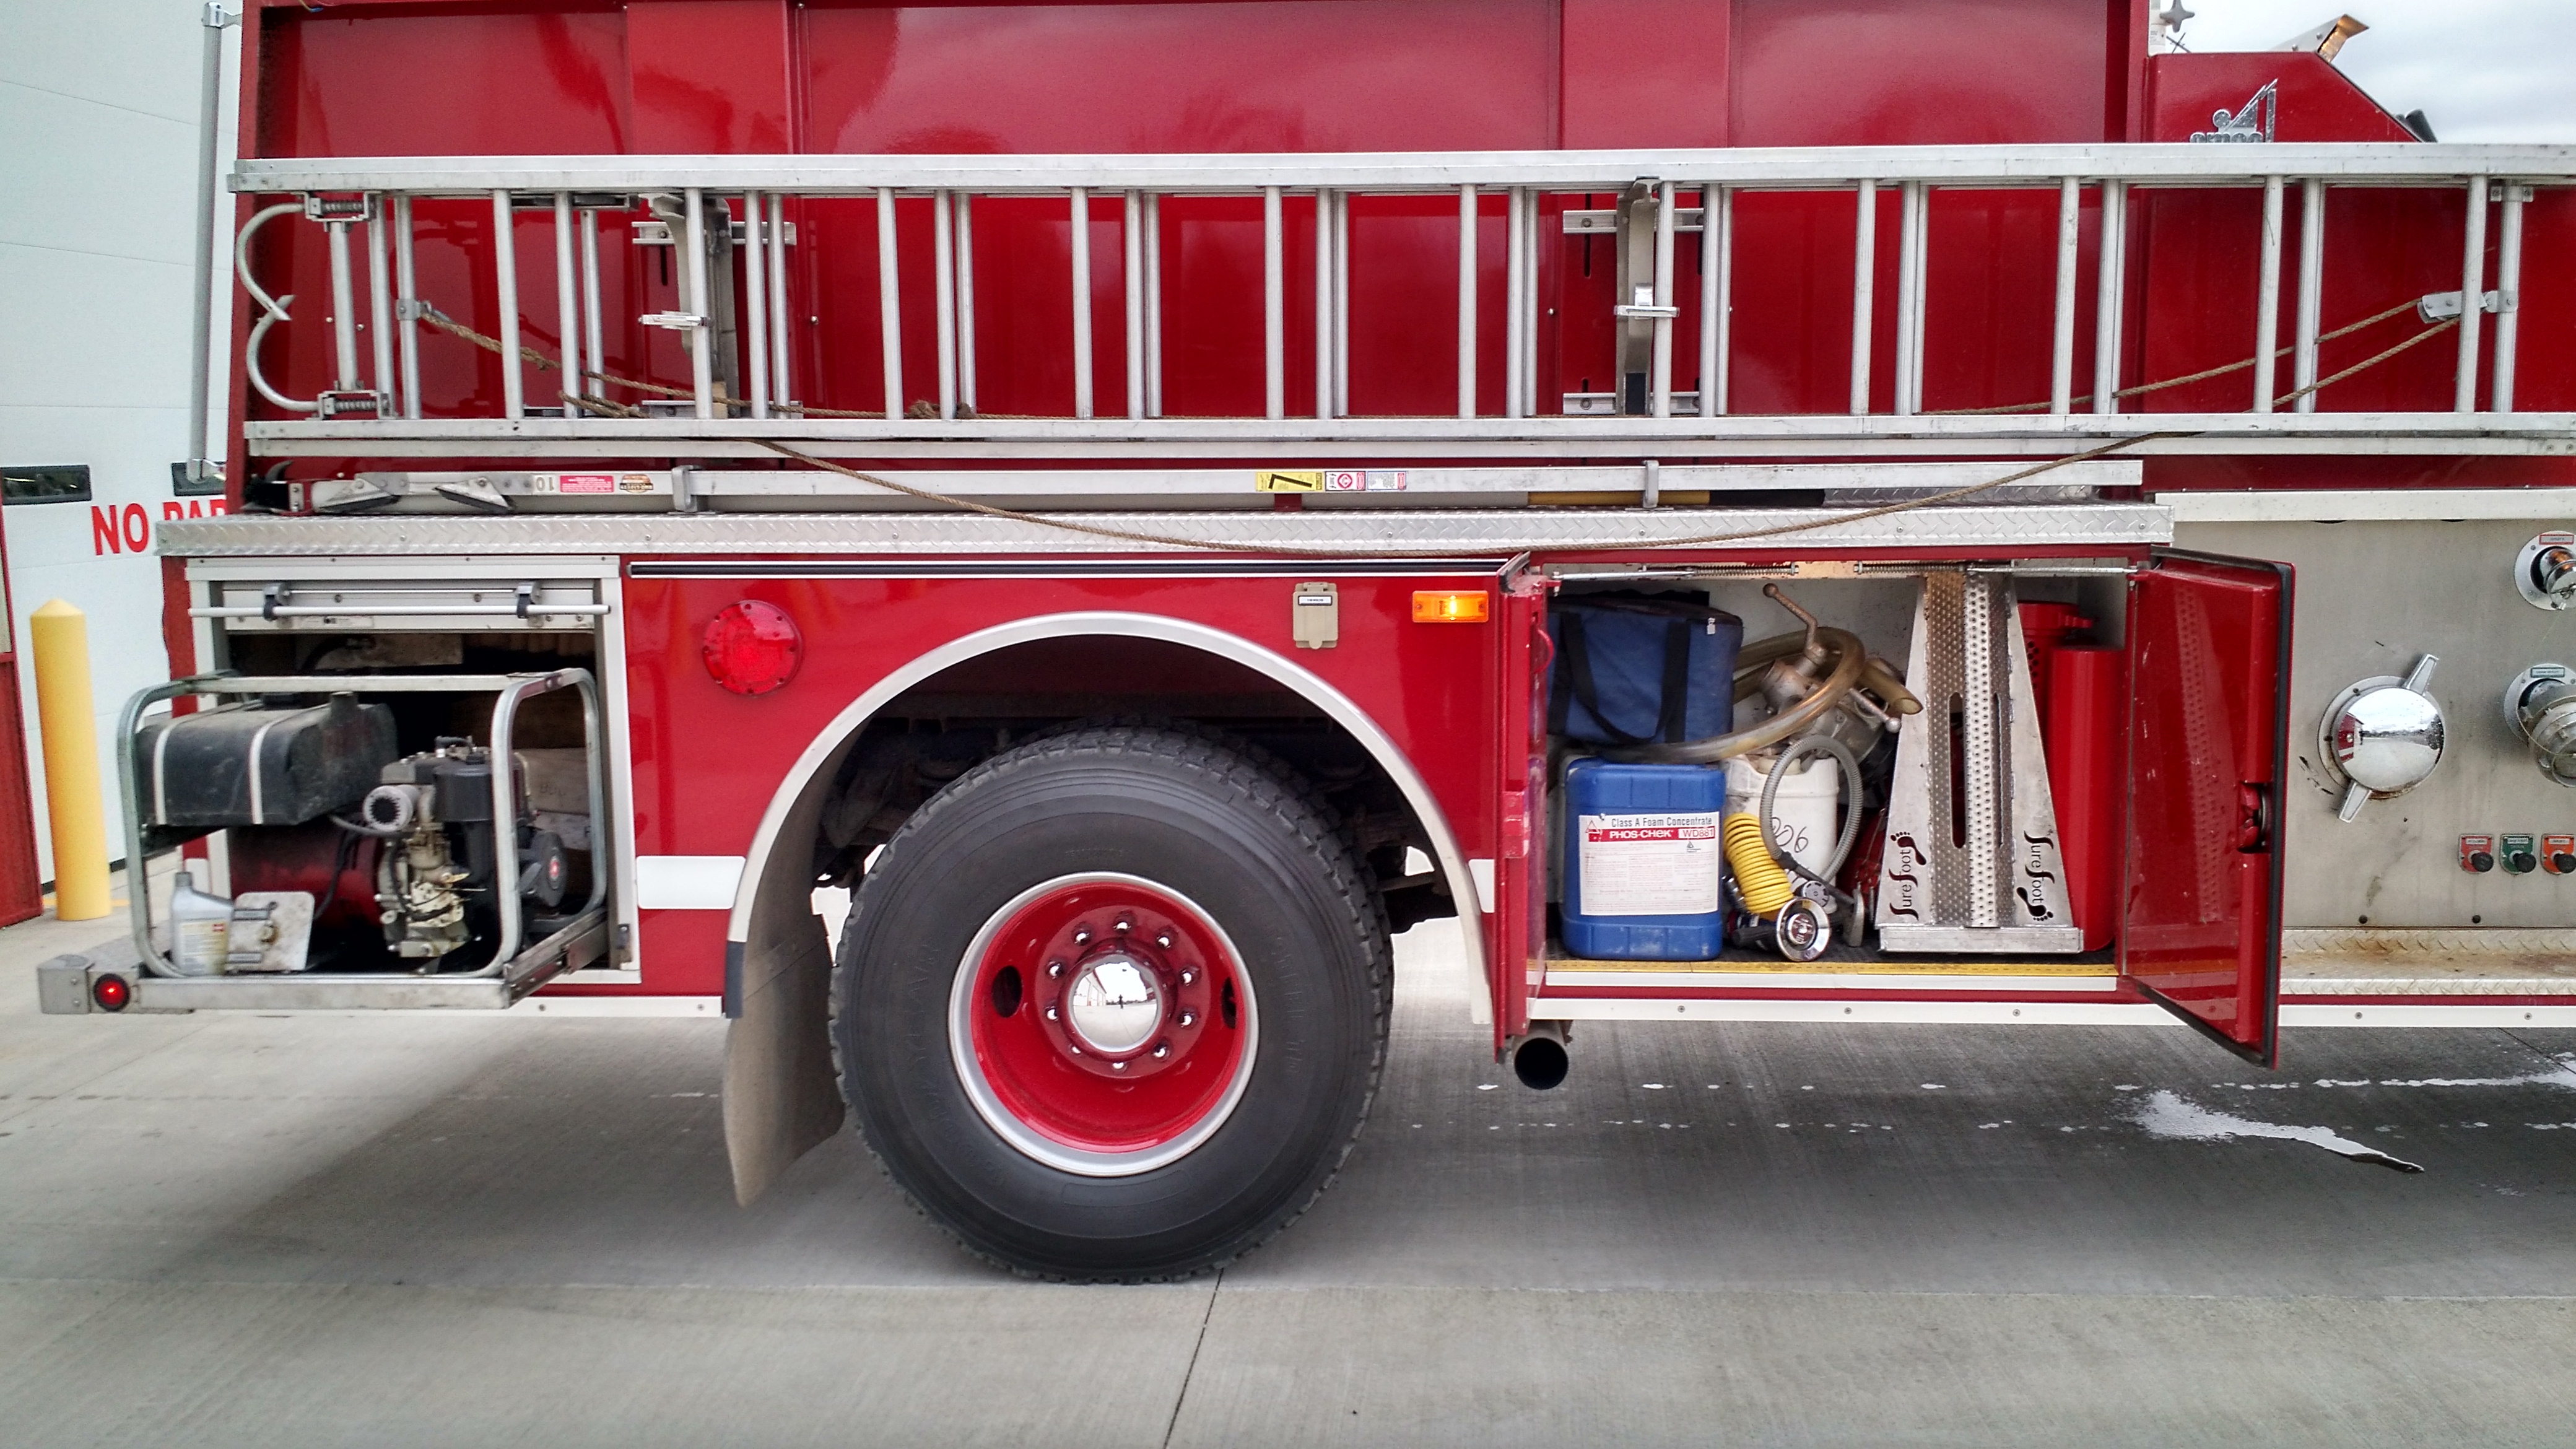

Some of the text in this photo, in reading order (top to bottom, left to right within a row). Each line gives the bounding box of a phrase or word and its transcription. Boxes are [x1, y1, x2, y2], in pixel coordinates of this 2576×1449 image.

[536, 476, 555, 492] 10
[91, 503, 149, 555] NO
[1611, 816, 1712, 827] Class A Foam Concentrate
[1682, 829, 1713, 837] WD881
